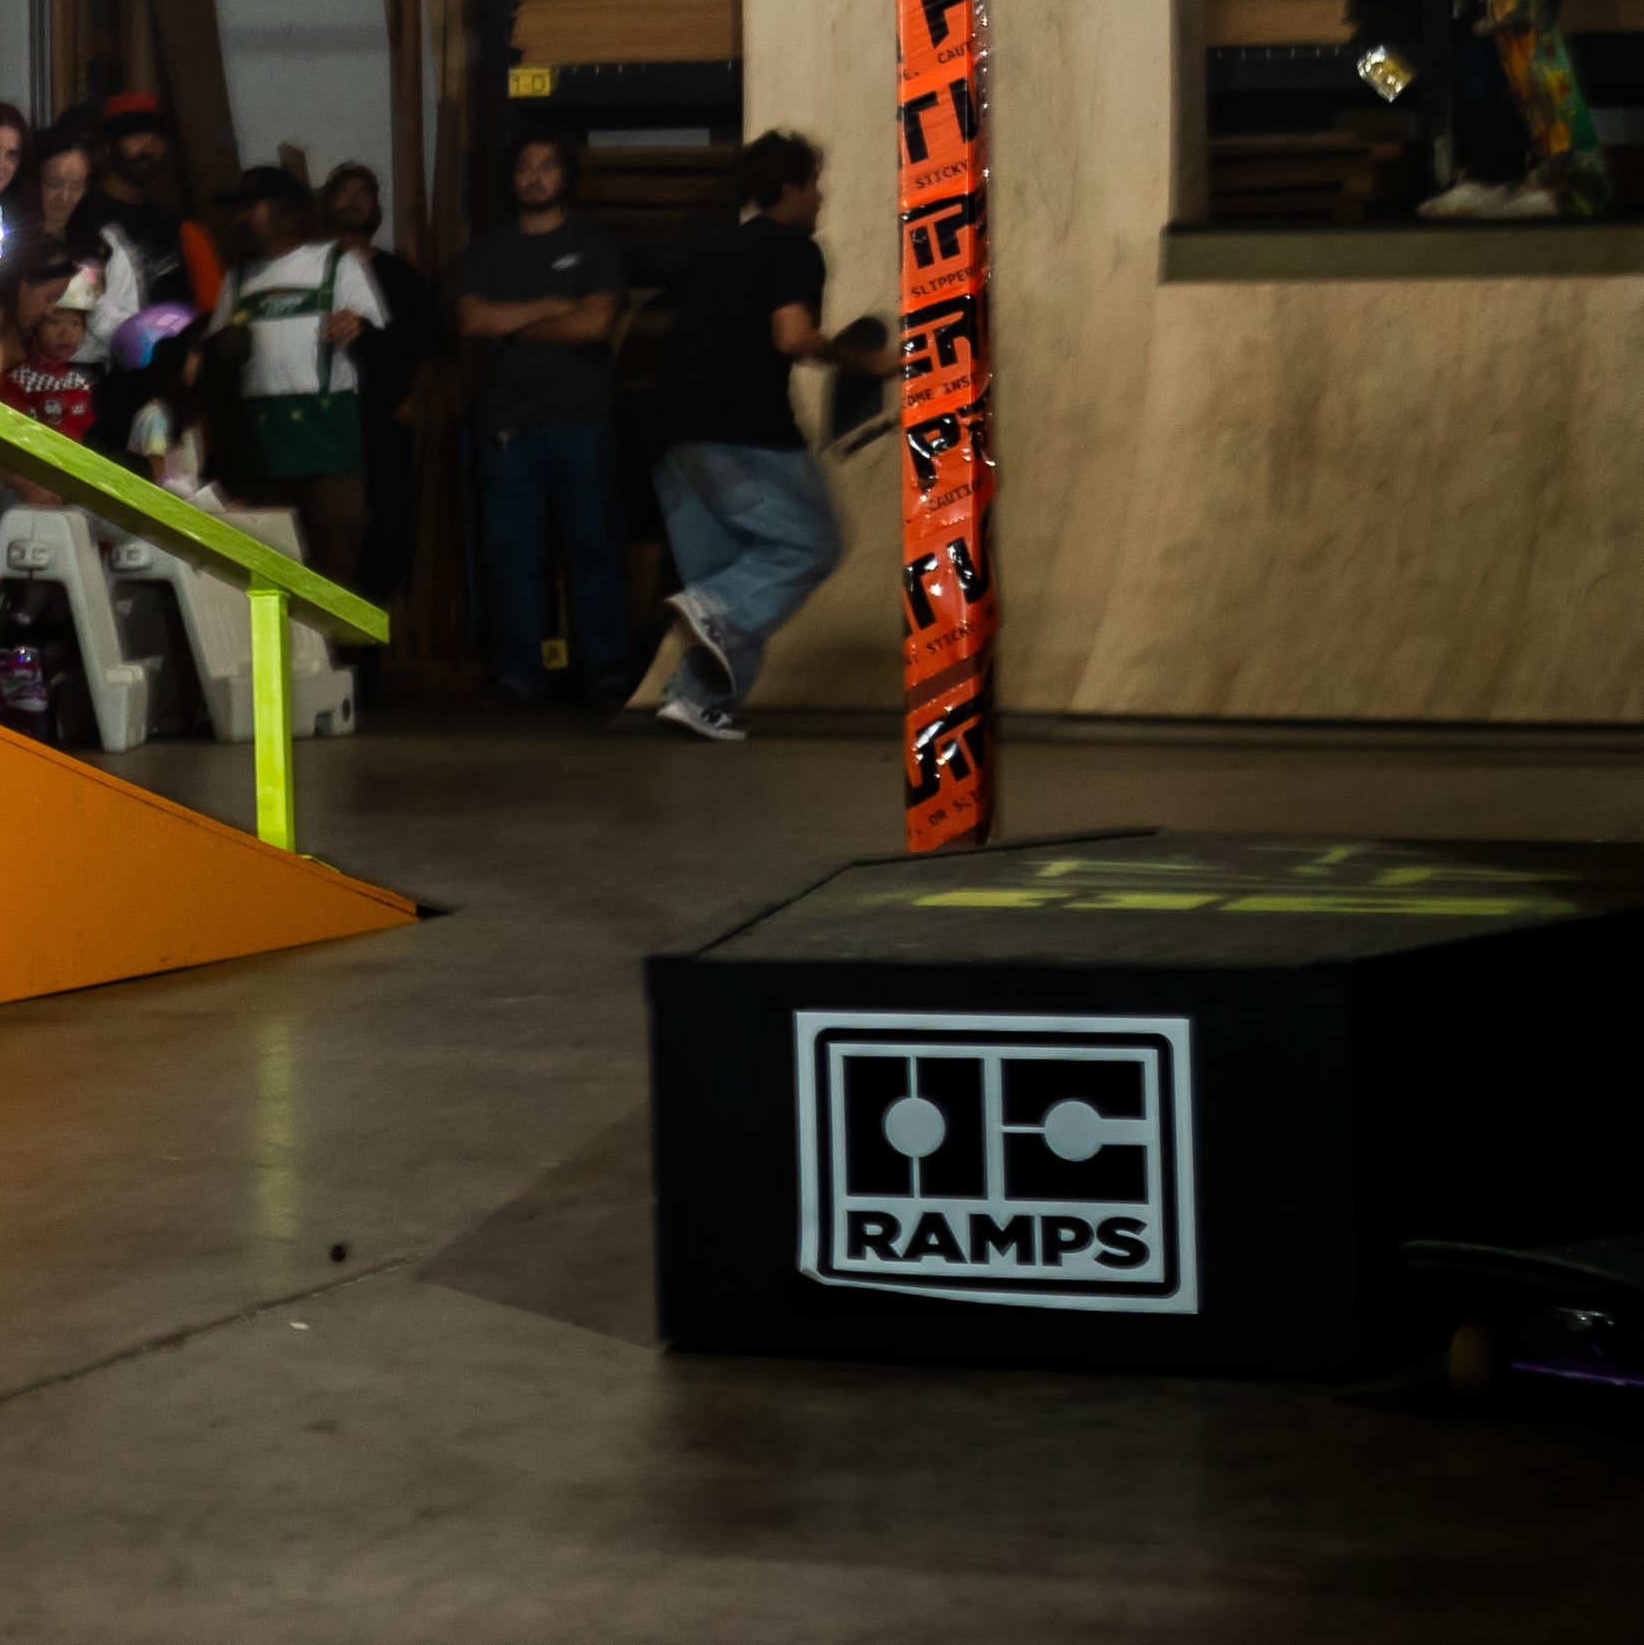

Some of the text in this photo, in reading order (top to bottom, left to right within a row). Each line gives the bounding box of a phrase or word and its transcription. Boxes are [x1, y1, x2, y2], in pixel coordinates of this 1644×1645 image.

[937, 42, 973, 65] CAUT
[911, 266, 976, 298] SLIPPER
[846, 1209, 1150, 1270] RAMPS
